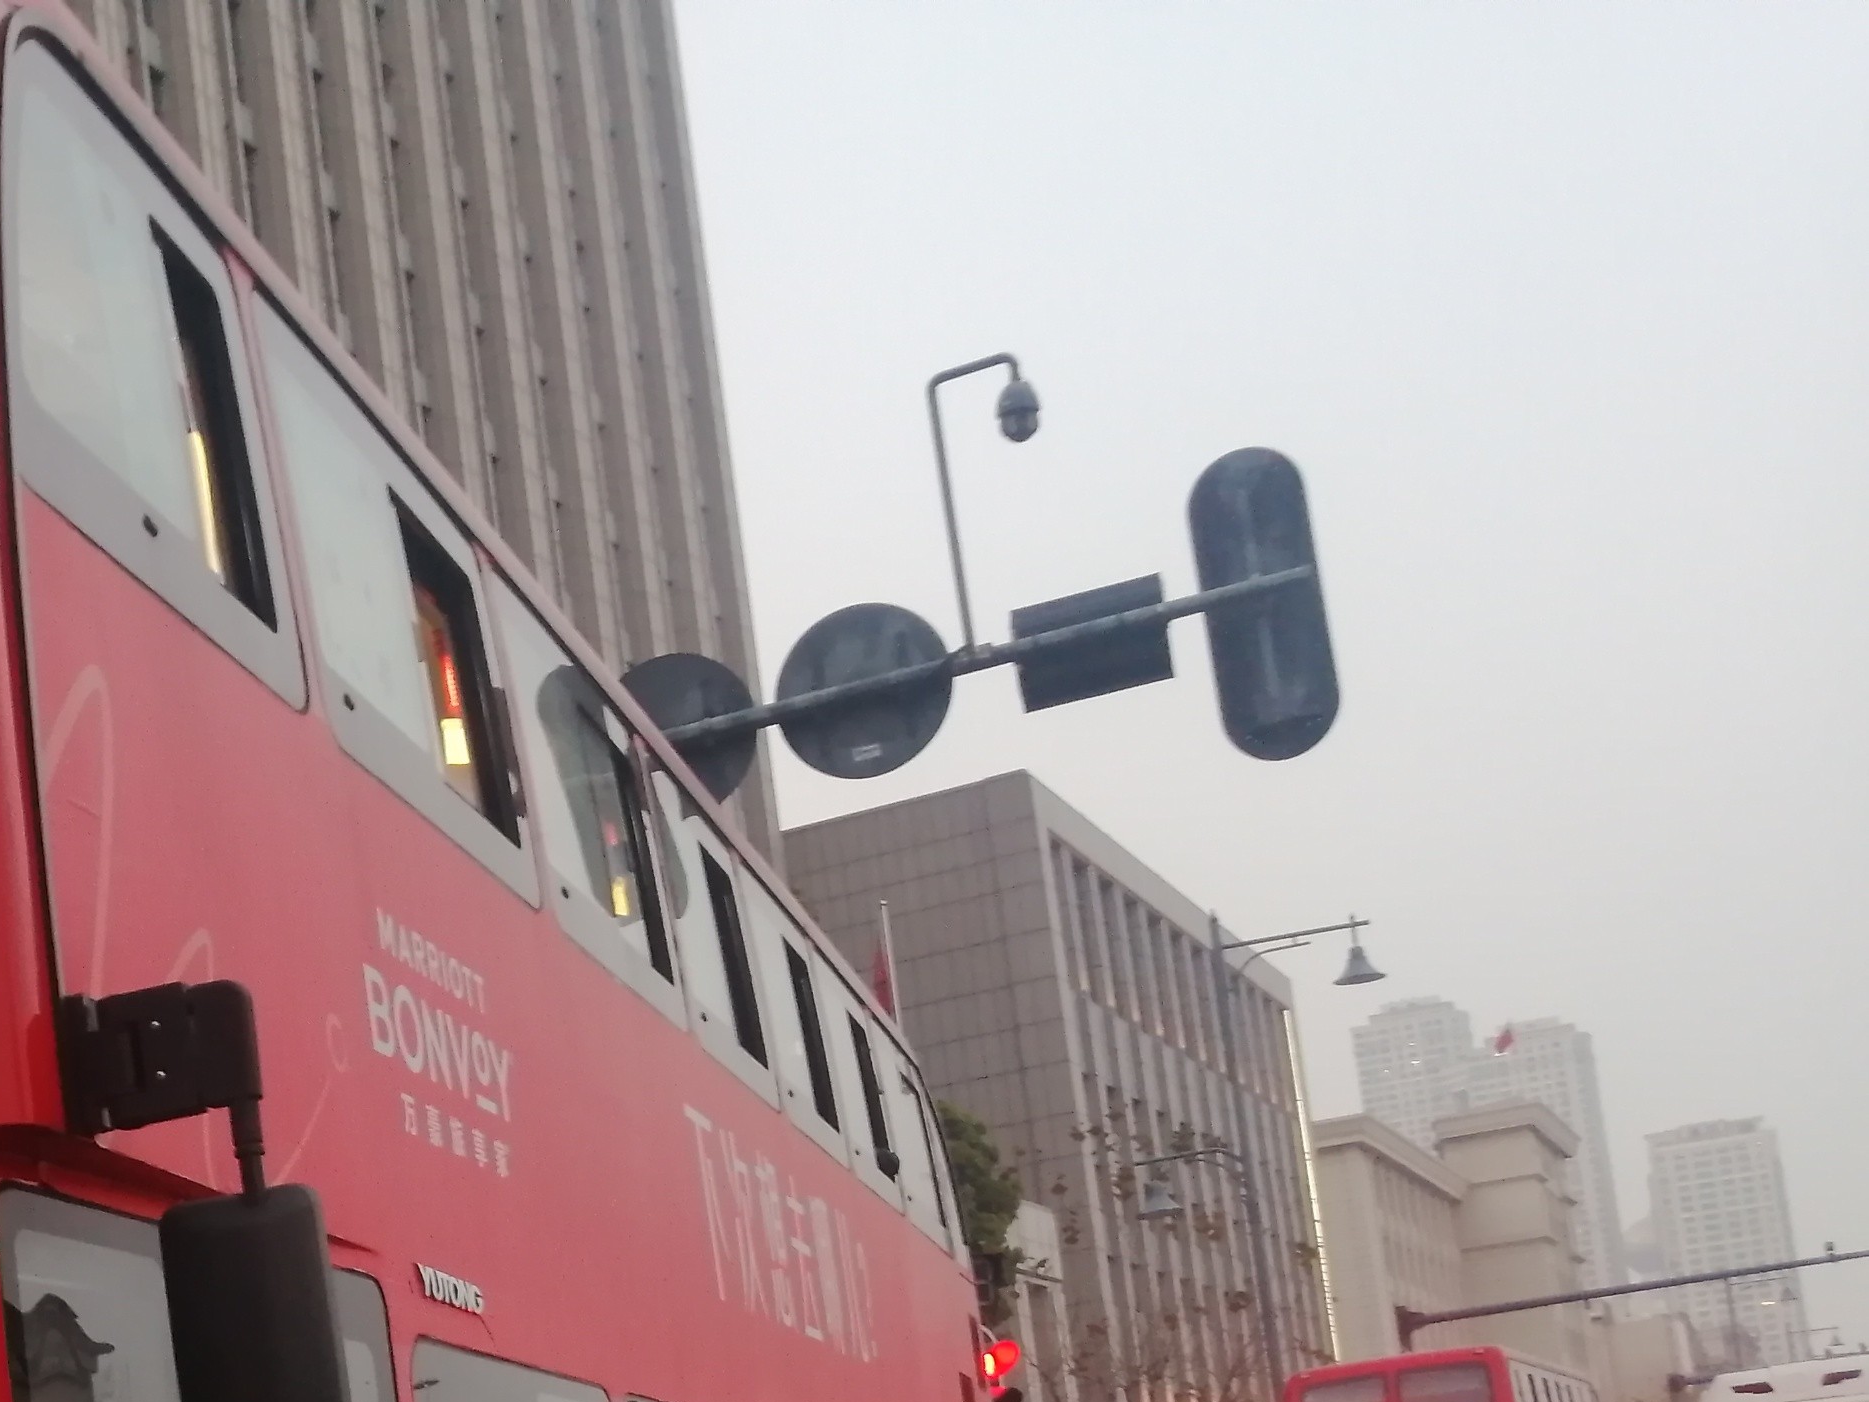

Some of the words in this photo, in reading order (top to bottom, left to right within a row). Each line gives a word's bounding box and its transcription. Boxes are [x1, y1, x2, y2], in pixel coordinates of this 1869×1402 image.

[376, 907, 485, 1014] MARRIOTT
[362, 963, 511, 1122] BONVOY
[416, 1262, 484, 1315] YUTONG
